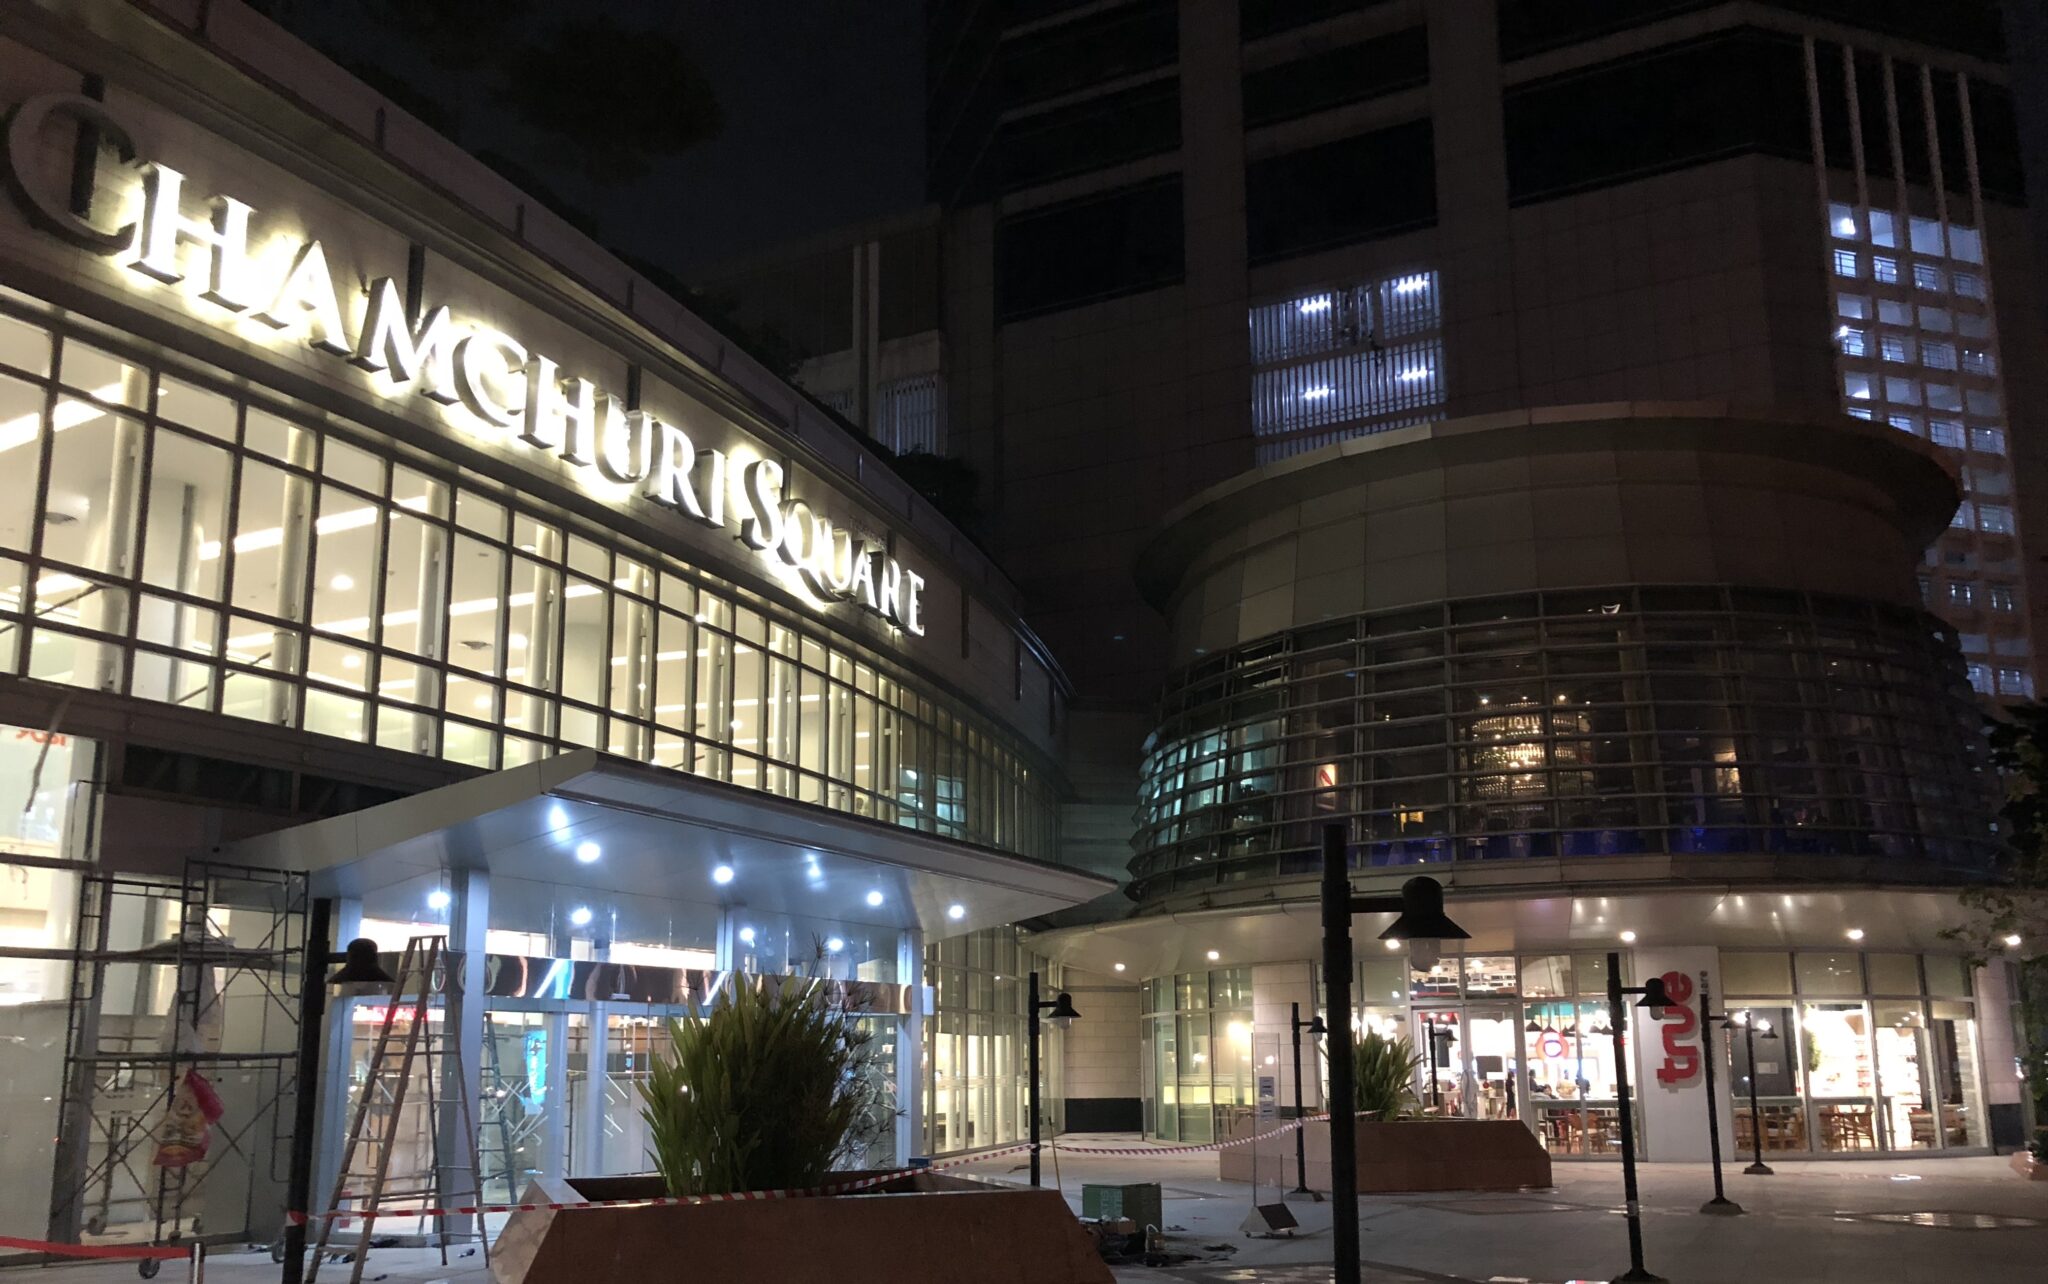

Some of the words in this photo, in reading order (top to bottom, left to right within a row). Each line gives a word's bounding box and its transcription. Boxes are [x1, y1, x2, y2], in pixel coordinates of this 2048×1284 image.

[0, 89, 726, 529] CHAMCHURI
[741, 458, 925, 637] SQUARE
[1656, 970, 1699, 1084] true
